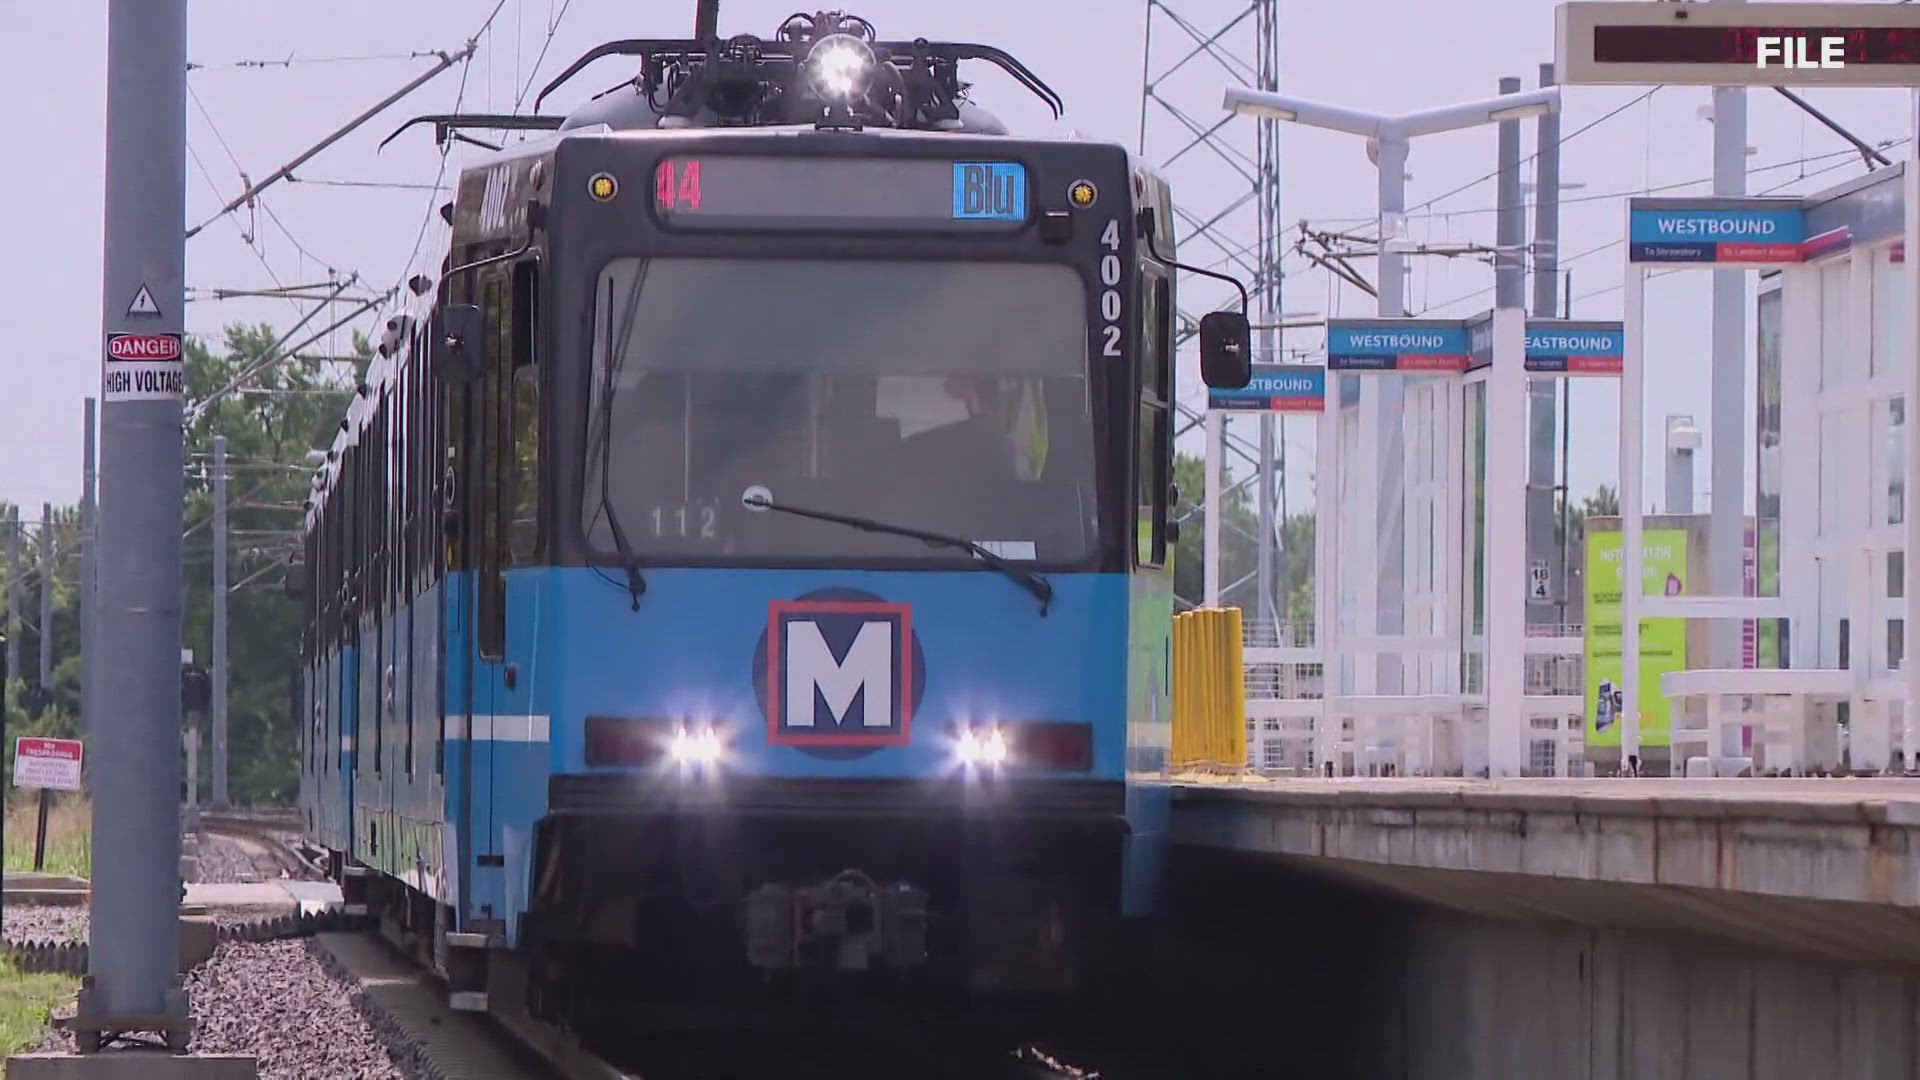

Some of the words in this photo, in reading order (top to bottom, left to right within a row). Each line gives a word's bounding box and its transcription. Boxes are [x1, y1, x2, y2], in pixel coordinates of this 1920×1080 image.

[656, 160, 701, 208] 44
[964, 165, 1015, 215] Blu
[1657, 218, 1775, 235] WESTBOUND
[1101, 219, 1122, 357] 4002
[112, 340, 178, 355] DANGER
[1350, 334, 1444, 348] WESTBOUND
[106, 371, 131, 394] HIGH
[135, 370, 183, 394] VOLTAGE
[1244, 379, 1313, 390] STBOUND
[787, 621, 892, 727] M
